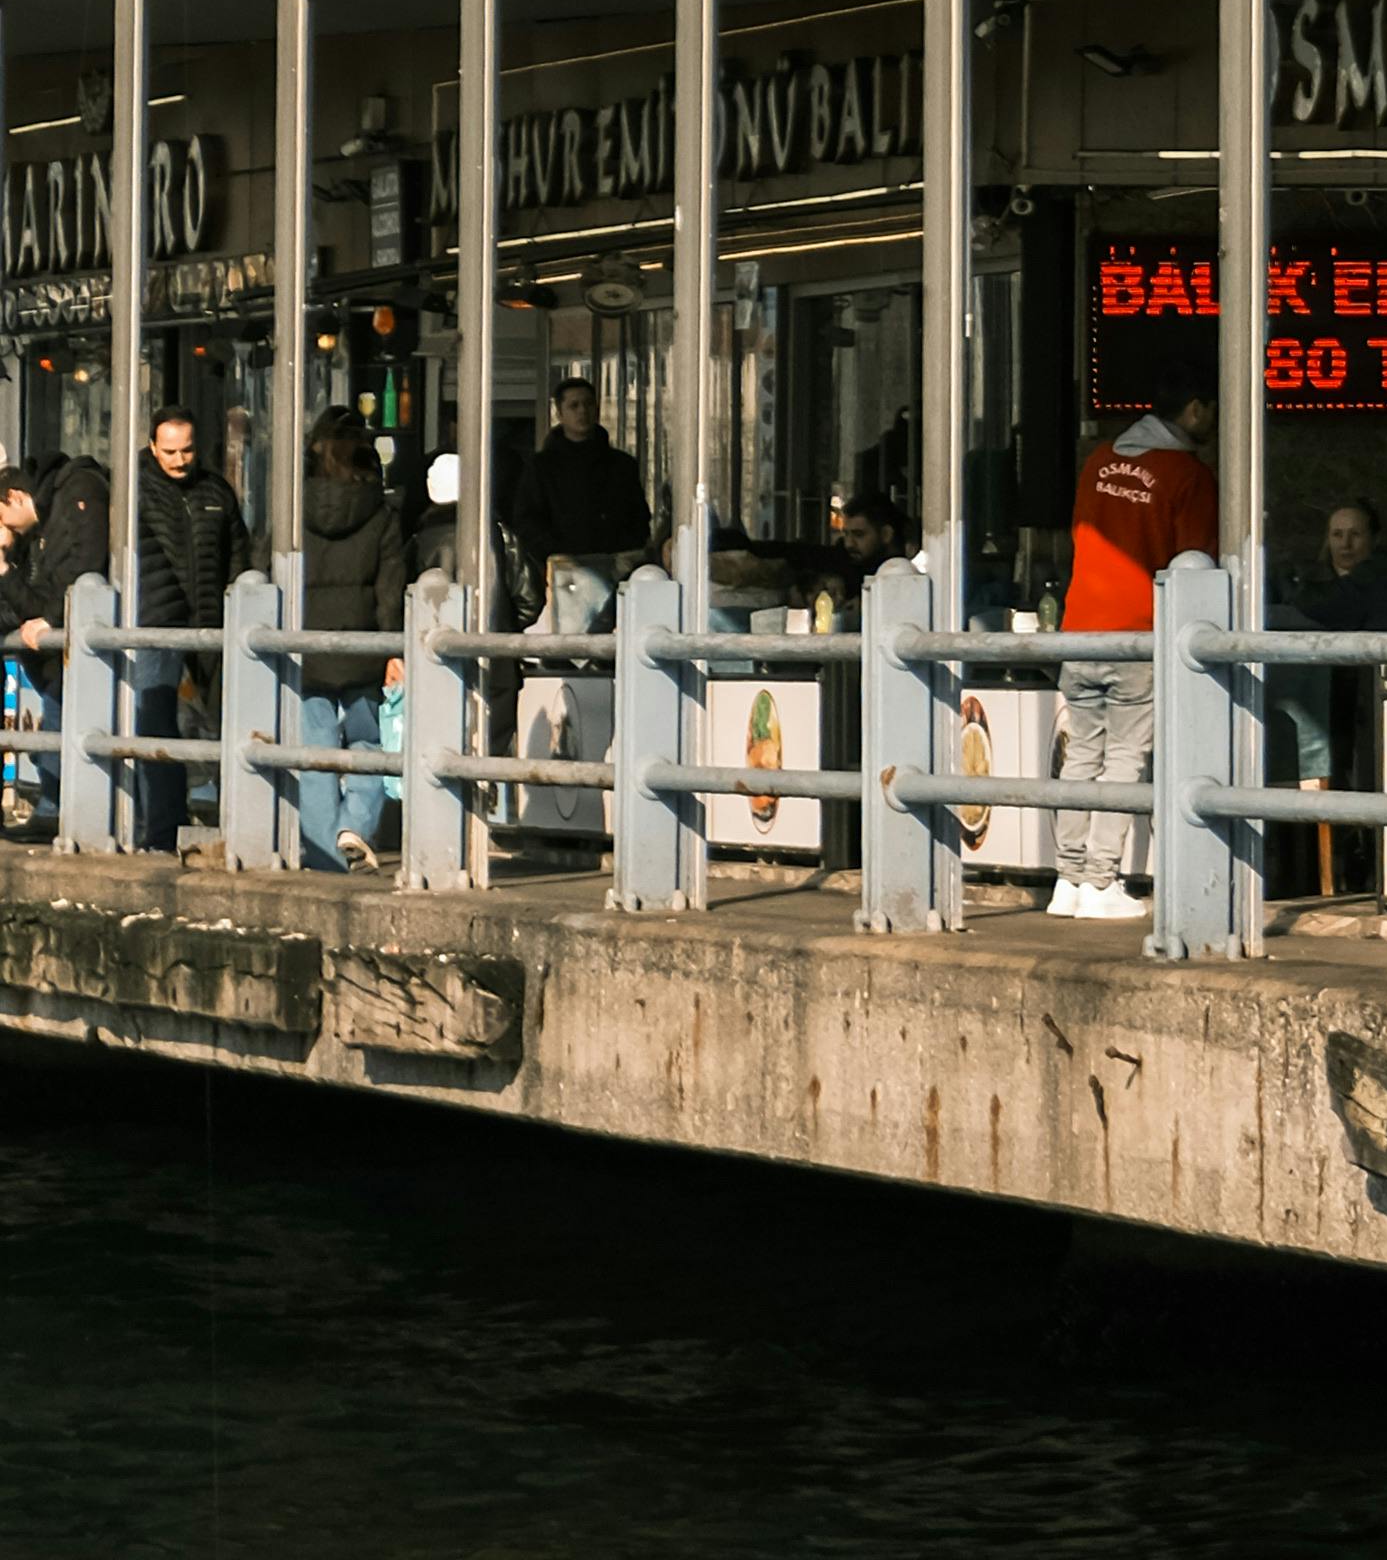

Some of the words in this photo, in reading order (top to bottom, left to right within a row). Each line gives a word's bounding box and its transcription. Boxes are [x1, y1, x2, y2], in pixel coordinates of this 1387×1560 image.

[808, 52, 914, 166] BALI
[2, 134, 208, 278] ARINRO
[1100, 260, 1313, 318] BALK
